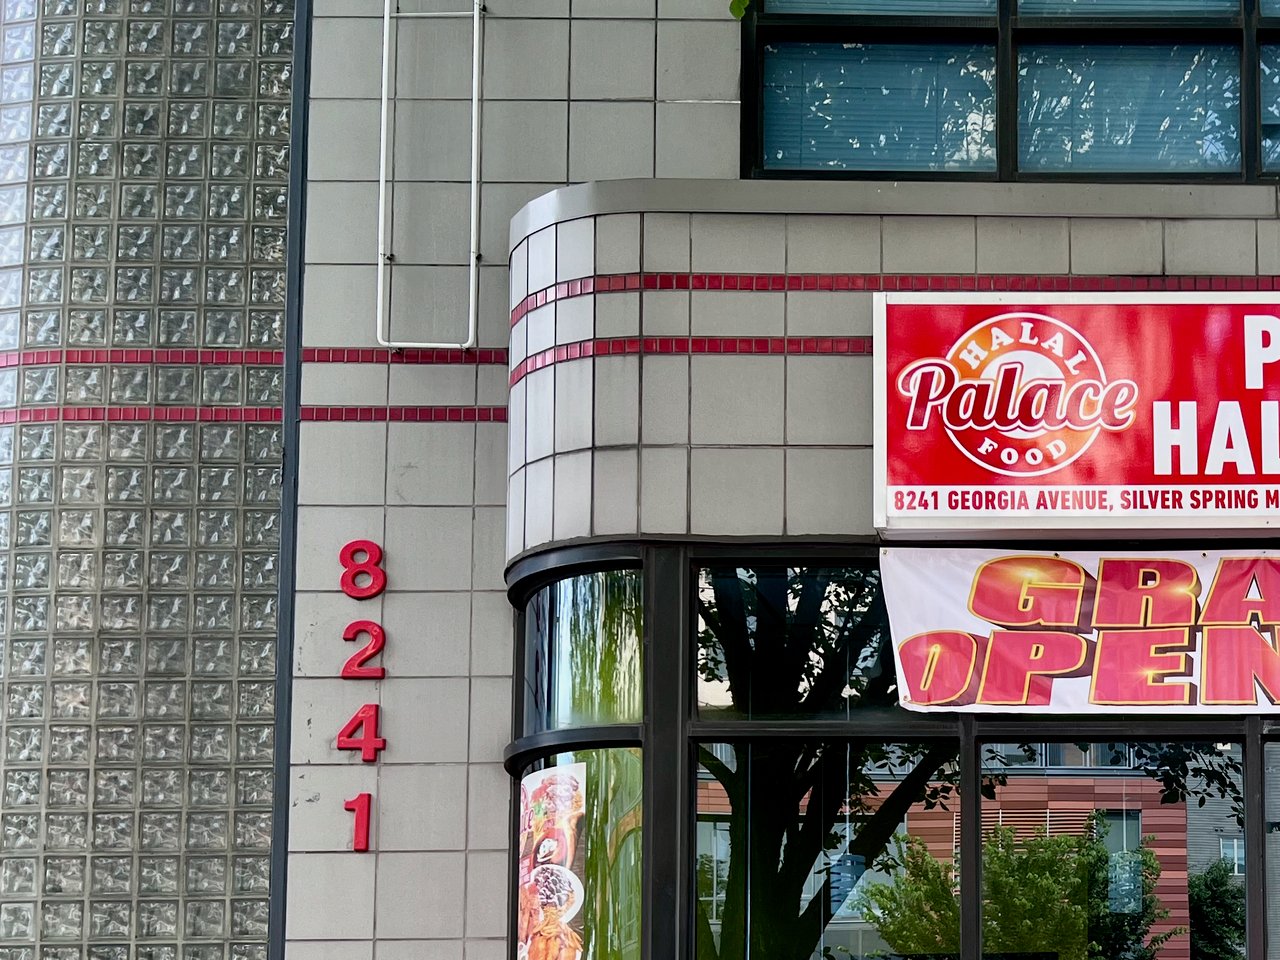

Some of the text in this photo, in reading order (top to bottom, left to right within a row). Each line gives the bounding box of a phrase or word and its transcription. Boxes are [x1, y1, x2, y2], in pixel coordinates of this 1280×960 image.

[959, 322, 1088, 376] HALAL
[897, 357, 1139, 431] Palace
[977, 437, 1067, 465] FOOD
[894, 490, 940, 510] 8241
[948, 490, 1030, 510] GEORGIA
[1036, 490, 1114, 512] AVENUE,
[1120, 489, 1184, 510] SILVER
[1190, 489, 1259, 509] SPRING
